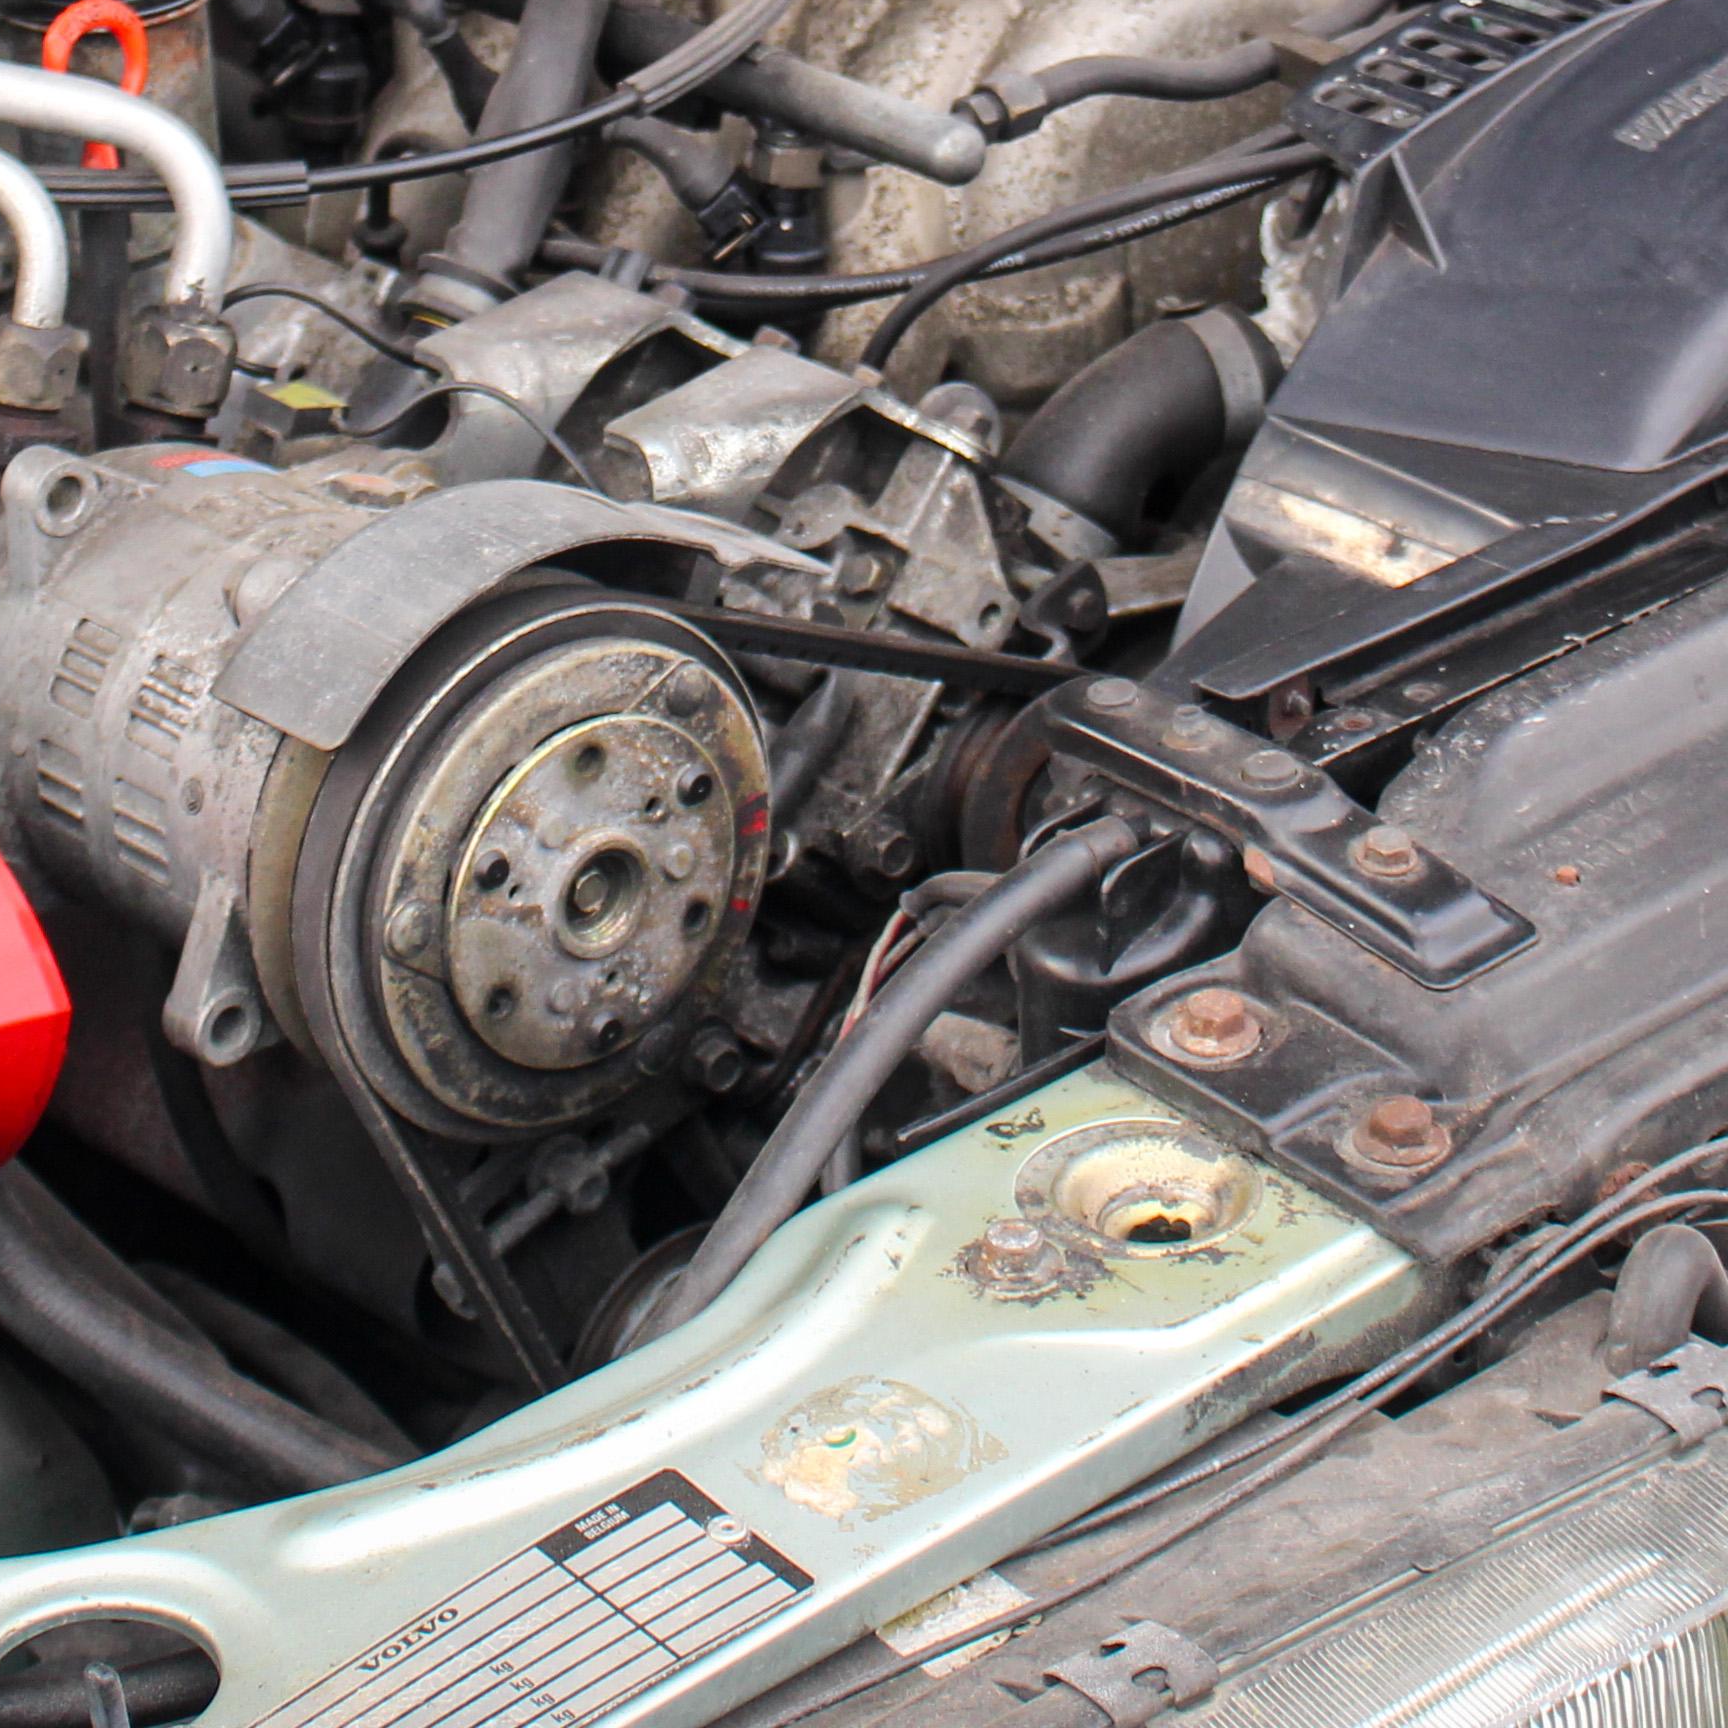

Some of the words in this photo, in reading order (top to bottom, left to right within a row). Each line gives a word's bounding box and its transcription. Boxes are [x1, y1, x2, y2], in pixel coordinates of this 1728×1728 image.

[574, 1509, 609, 1533] MADE
[603, 1502, 621, 1516] IN
[583, 1509, 631, 1541] BELGIUM
[357, 1607, 459, 1672] VOLVO
[489, 1659, 515, 1677] kg
[510, 1676, 535, 1693] kg
[530, 1691, 556, 1708] kg
[551, 1707, 576, 1724] kg
